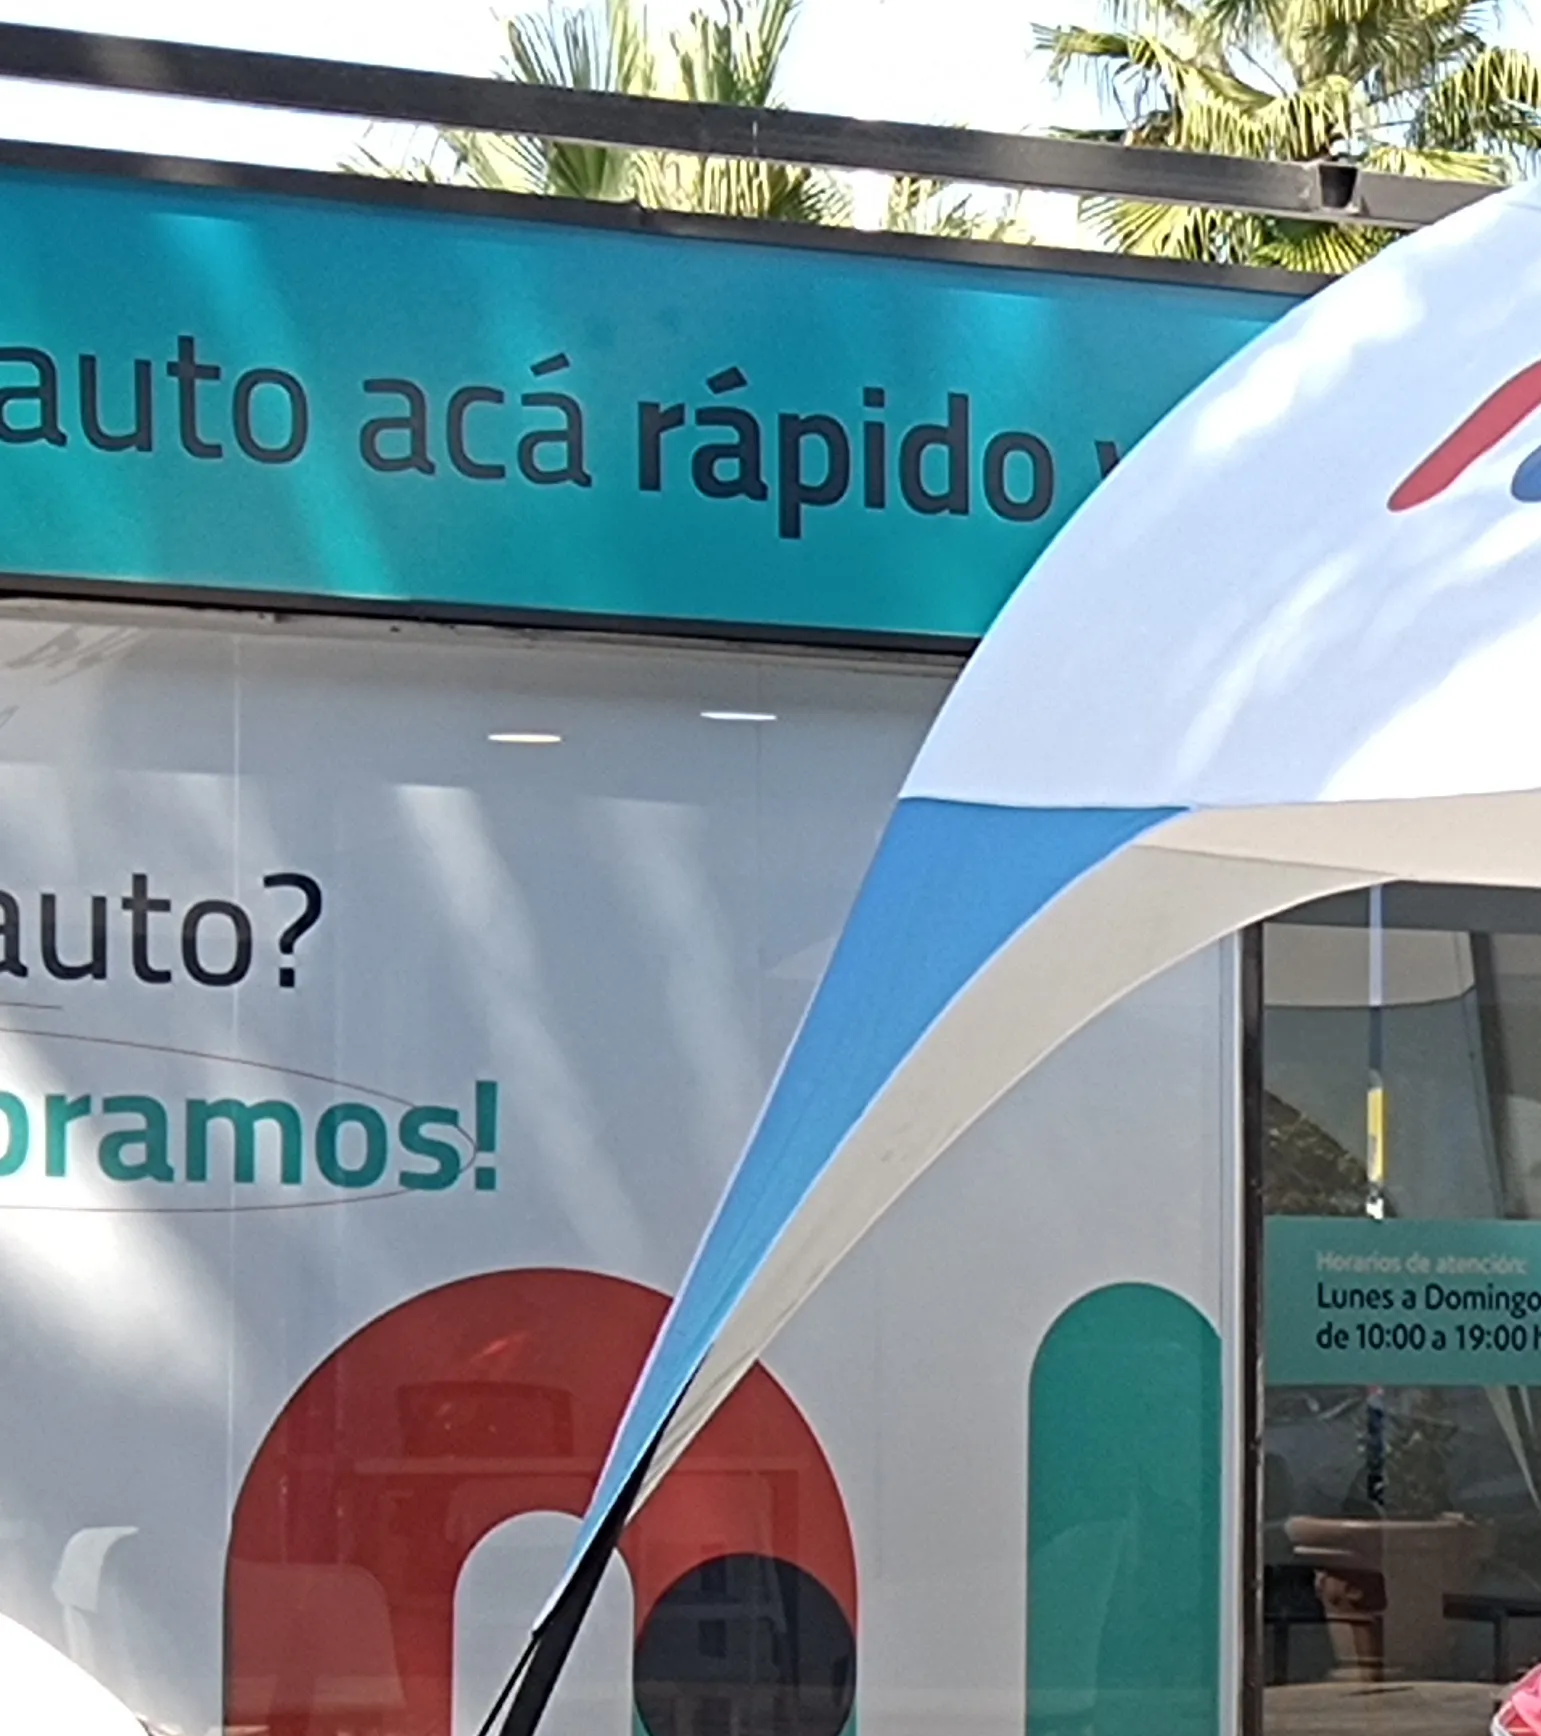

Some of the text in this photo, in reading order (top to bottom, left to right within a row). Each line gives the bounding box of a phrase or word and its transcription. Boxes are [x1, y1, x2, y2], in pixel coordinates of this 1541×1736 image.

[0, 335, 1054, 540] auto acá rápido
[1316, 1251, 1400, 1273] Horarios
[1405, 1252, 1431, 1274] de
[1317, 1282, 1394, 1310] Lunes
[1401, 1289, 1417, 1310] a
[1316, 1322, 1350, 1350] de
[1356, 1323, 1426, 1350] 10:00
[1431, 1330, 1446, 1350] a
[1456, 1324, 1527, 1351] 19:00
